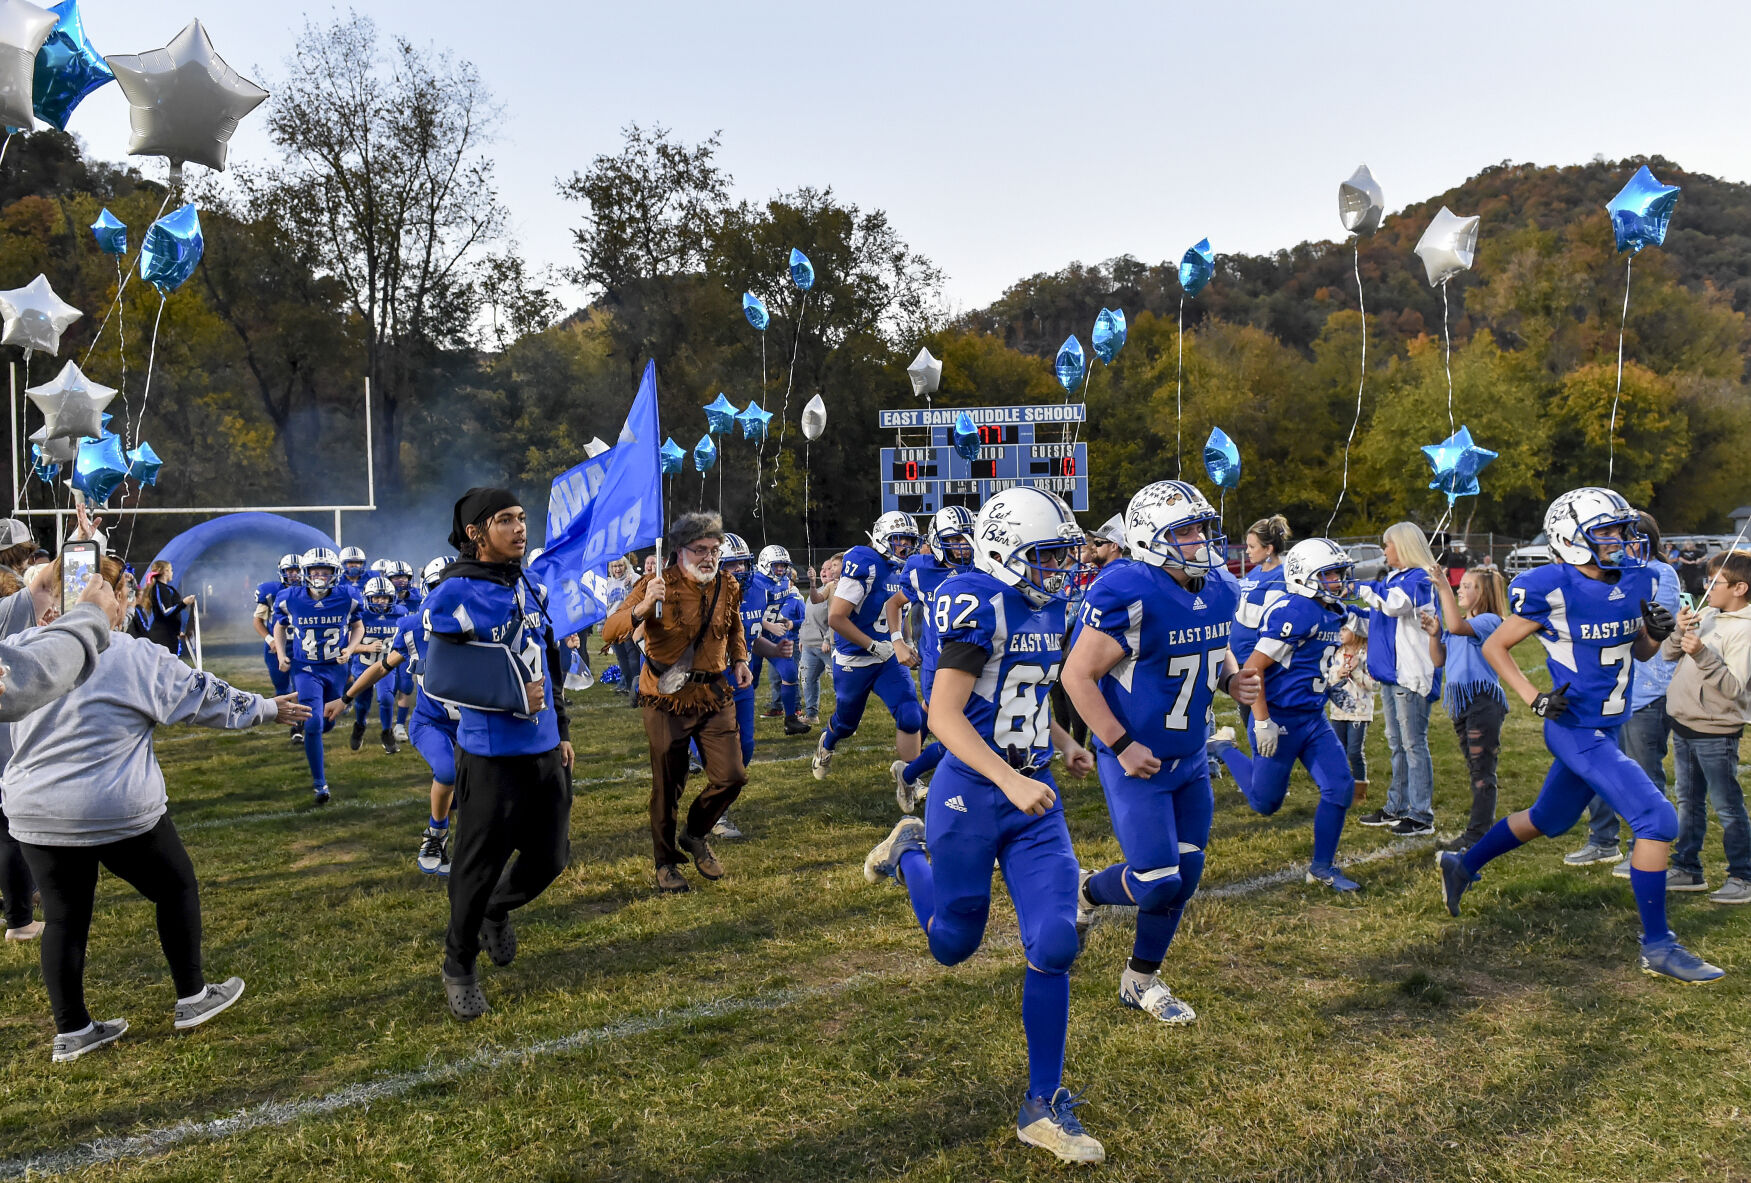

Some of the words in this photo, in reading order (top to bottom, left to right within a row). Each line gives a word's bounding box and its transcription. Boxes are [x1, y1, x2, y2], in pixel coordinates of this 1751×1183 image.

[883, 411, 918, 426] EAST
[968, 408, 1020, 423] MIDDLE
[1024, 406, 1081, 421] SCHOOL
[901, 449, 930, 461] HOME
[976, 446, 1004, 459] RIOD
[1031, 444, 1074, 458] GUESTS
[905, 460, 918, 481] 0
[991, 460, 997, 478] 1
[1063, 457, 1075, 477] 0
[894, 483, 912, 495] BALL
[914, 482, 927, 494] ON
[989, 480, 1017, 492] DOWN
[1051, 478, 1063, 490] TO
[1064, 478, 1076, 490] GO
[844, 560, 859, 577] 67
[1511, 587, 1526, 613] 7
[298, 617, 318, 625] EAST
[321, 616, 343, 624] BANK
[934, 594, 979, 633] 82
[1080, 601, 1103, 628] 75
[365, 626, 382, 634] EAST
[1168, 627, 1201, 645] EAST
[1204, 621, 1232, 640] BANK
[1280, 622, 1293, 637] 9
[1580, 622, 1620, 640] EAST
[302, 628, 341, 661] 42
[1009, 633, 1042, 652] EAST
[1600, 641, 1634, 716] 7
